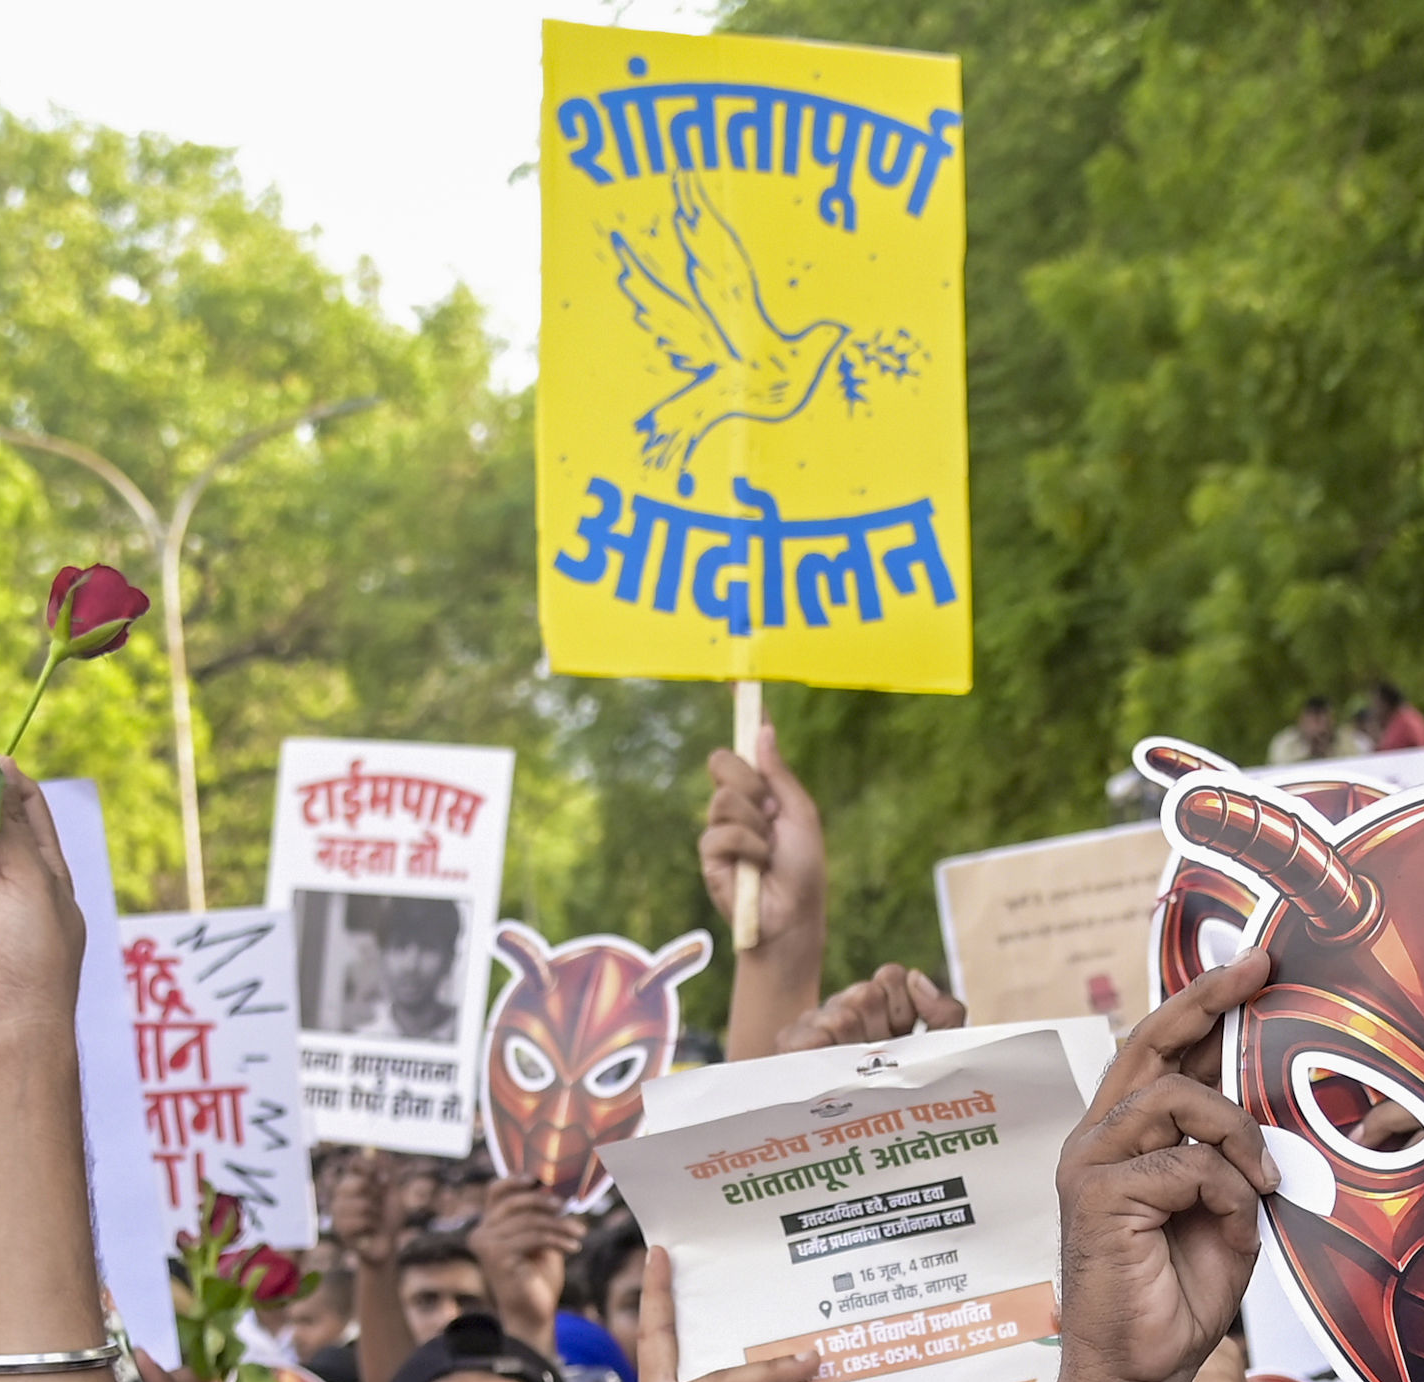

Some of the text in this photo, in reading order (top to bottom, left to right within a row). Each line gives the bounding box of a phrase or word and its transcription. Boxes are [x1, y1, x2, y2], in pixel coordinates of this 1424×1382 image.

[556, 55, 962, 234] शांततापूर्ण
[553, 475, 957, 637] आंदोलन
[297, 760, 484, 835] टाईमपास
[685, 1090, 996, 1180] कॉकरोच जनता पक्षाचे
[722, 1123, 998, 1205] शांततापूर्ण आंदोलन
[860, 1250, 959, 1283] 16 जून, 4 वाजता
[925, 1273, 968, 1297] नागपूर
[828, 1326, 867, 1353] कोटी
[928, 1302, 992, 1332] प्रभावित
[968, 1328, 995, 1346] SSC
